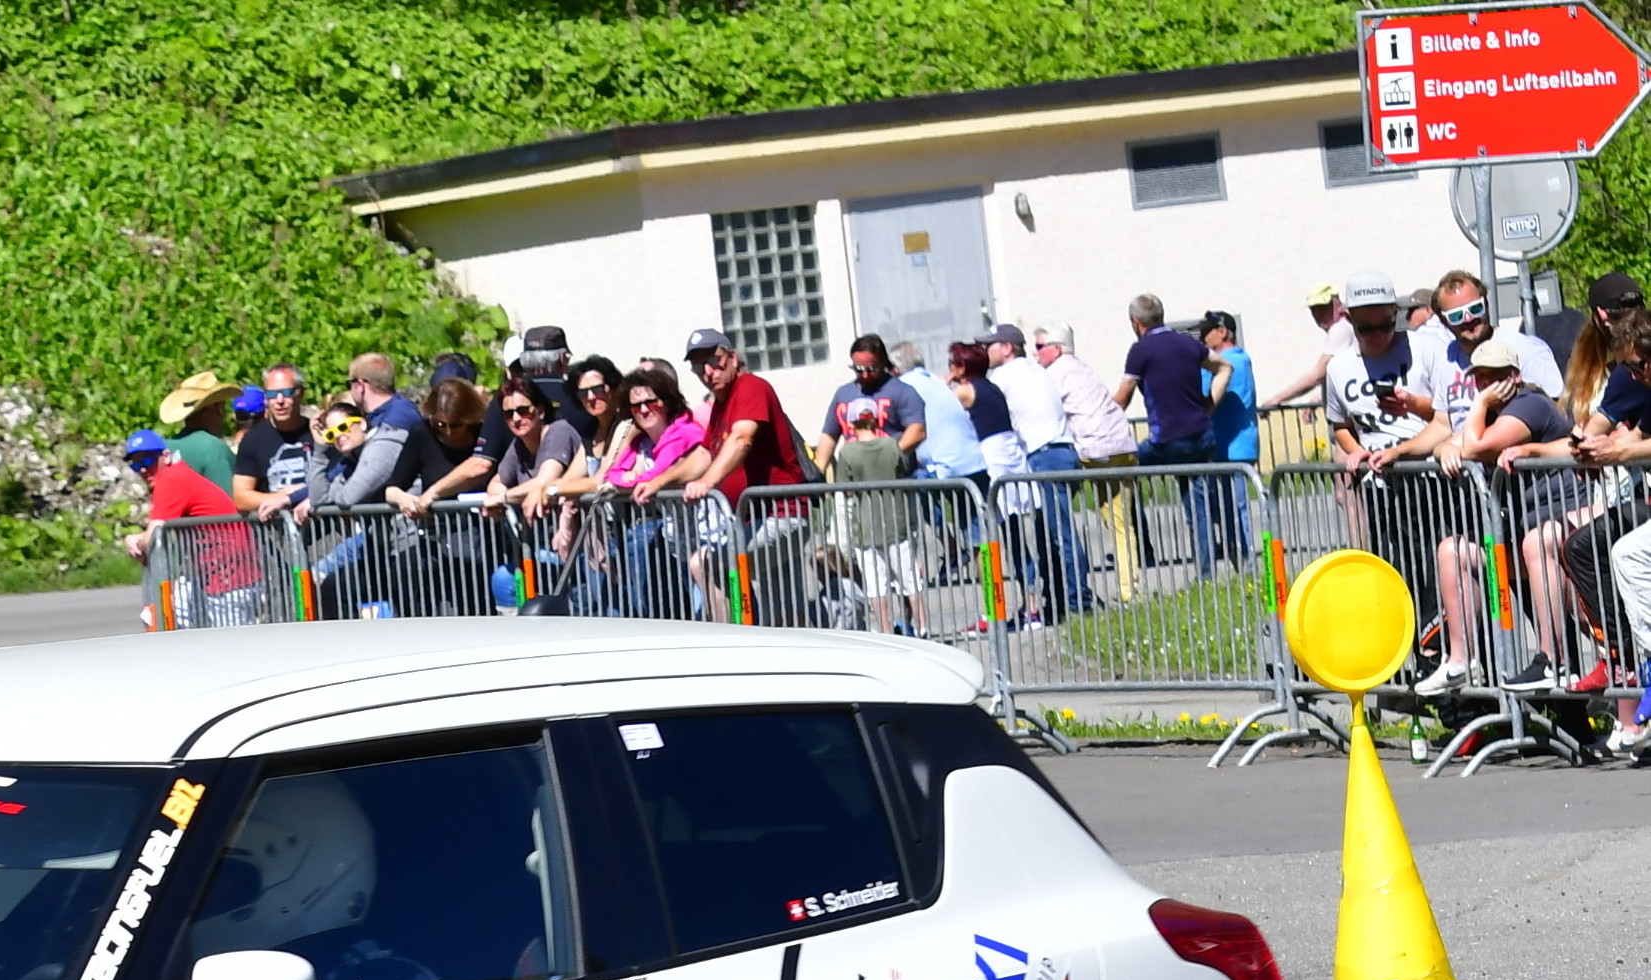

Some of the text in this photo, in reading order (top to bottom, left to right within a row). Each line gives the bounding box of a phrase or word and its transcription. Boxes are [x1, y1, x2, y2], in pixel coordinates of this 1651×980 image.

[1420, 34, 1482, 55] Billete
[1485, 31, 1501, 50] &
[1505, 28, 1541, 49] Info
[1423, 68, 1617, 99] Eingang Luftseilbahn
[1425, 122, 1458, 141] WC
